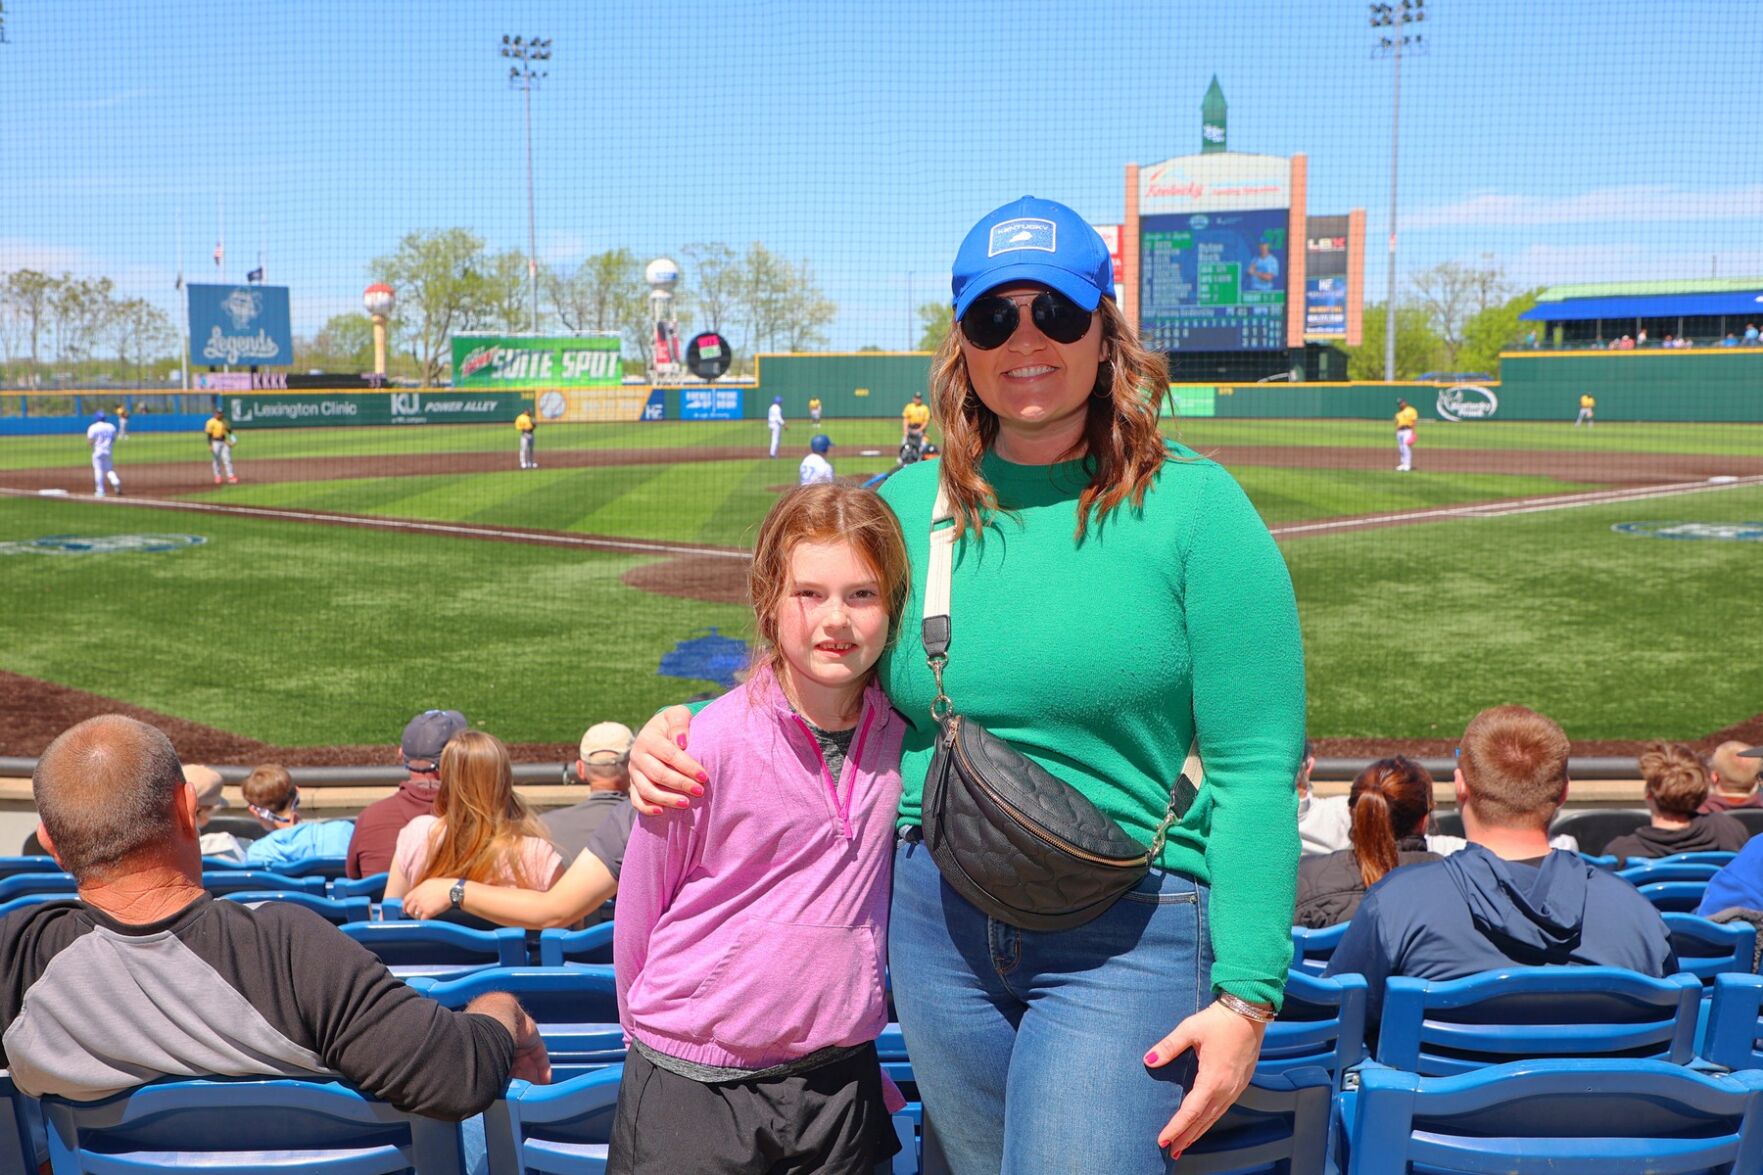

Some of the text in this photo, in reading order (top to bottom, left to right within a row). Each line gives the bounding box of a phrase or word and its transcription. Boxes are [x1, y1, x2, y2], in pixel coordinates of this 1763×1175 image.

[997, 223, 1049, 234] KENTUCKY
[203, 325, 279, 365] Legends
[491, 348, 554, 379] SUITE
[561, 348, 620, 379] SPOT
[254, 400, 357, 419] Lexington Clinic
[424, 400, 463, 413] POWER
[464, 400, 498, 412] ALLEY
[800, 464, 816, 485] 27
